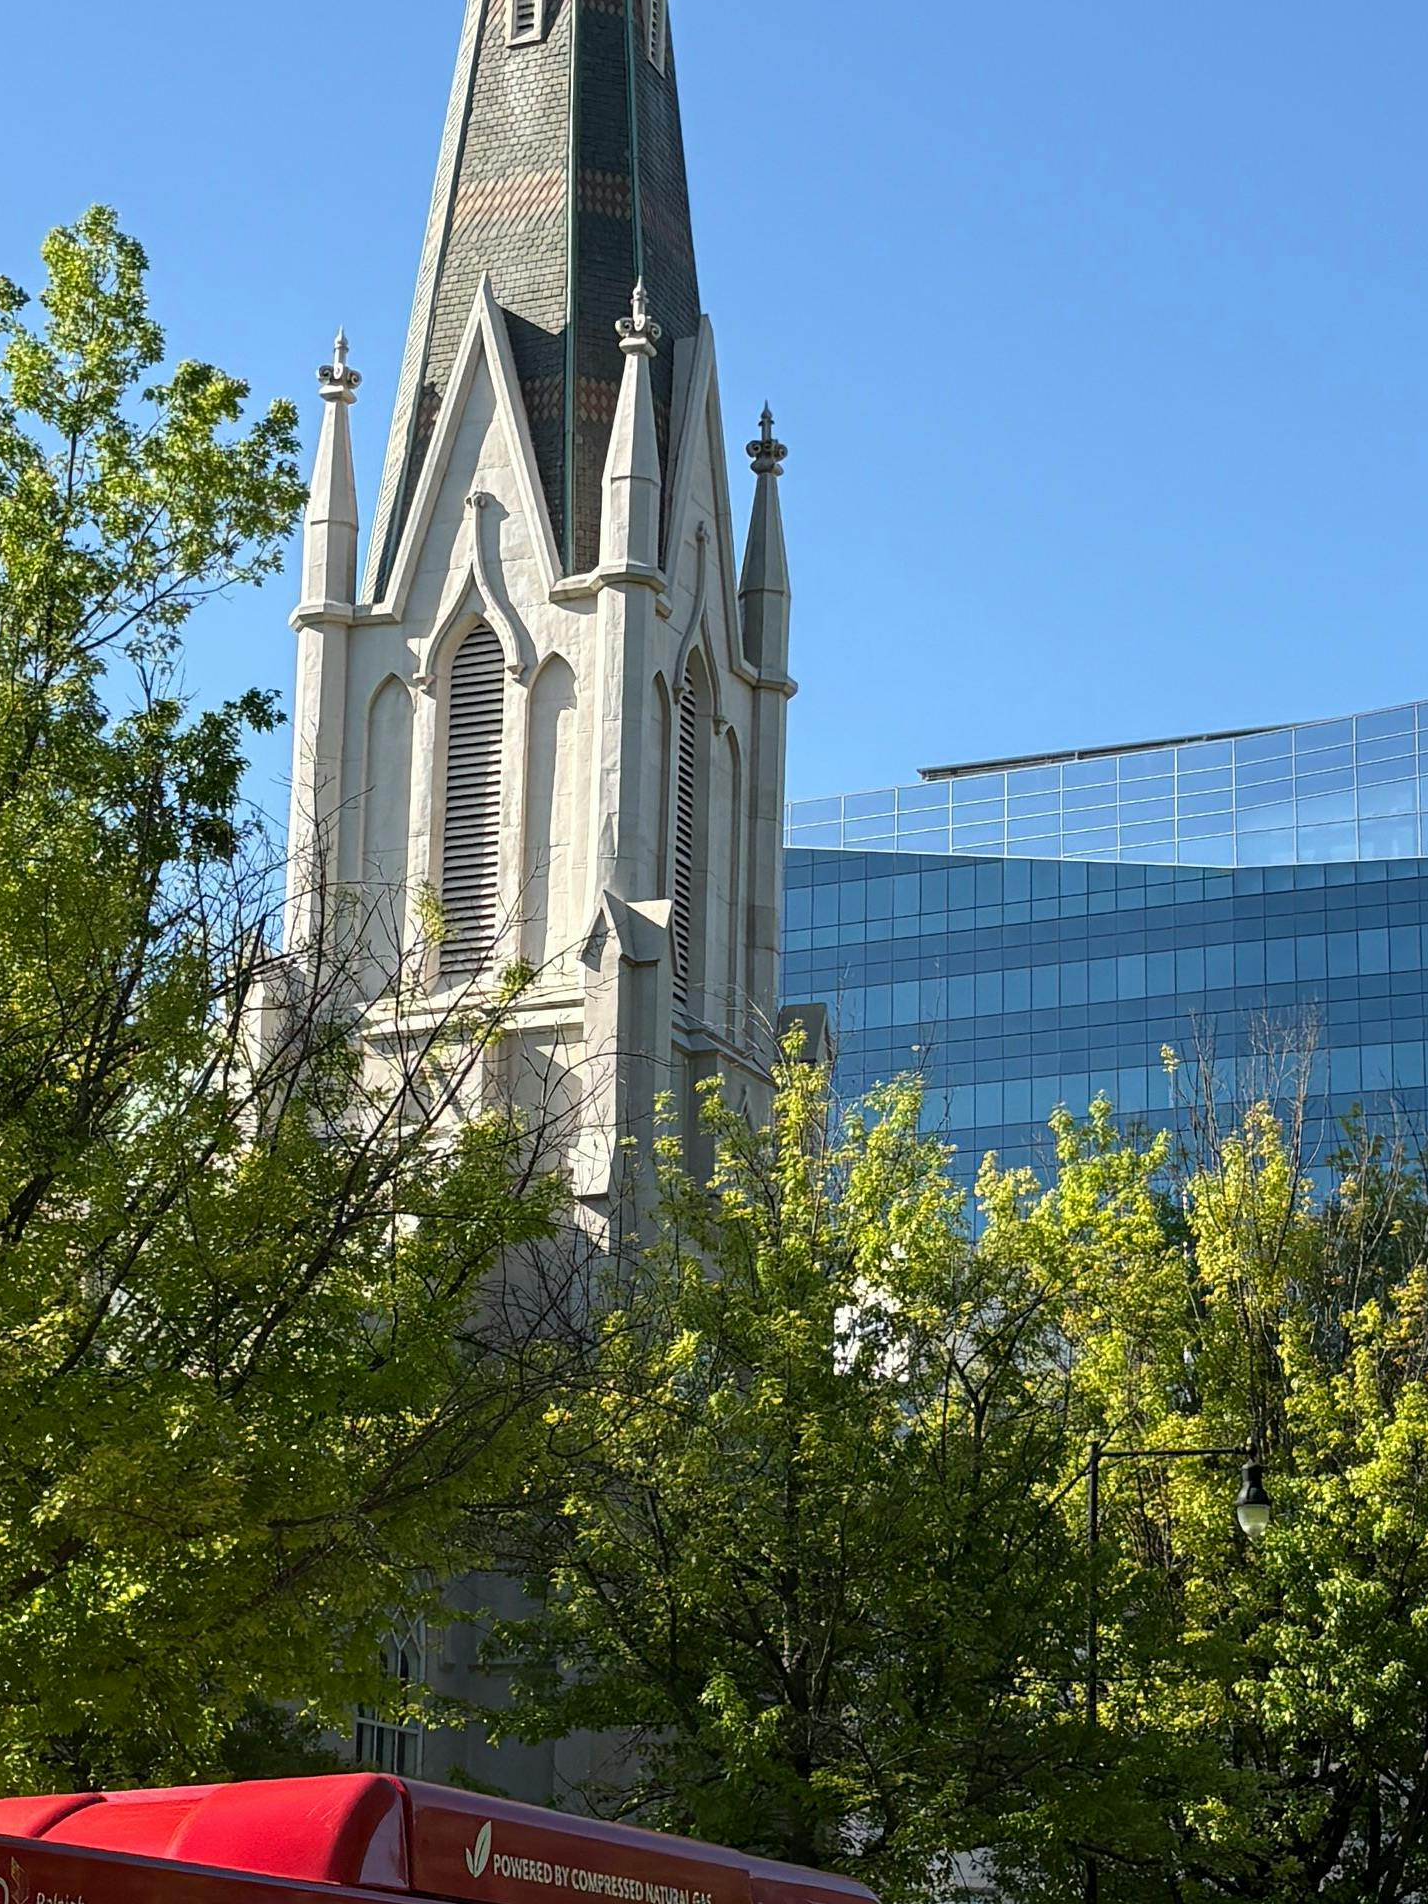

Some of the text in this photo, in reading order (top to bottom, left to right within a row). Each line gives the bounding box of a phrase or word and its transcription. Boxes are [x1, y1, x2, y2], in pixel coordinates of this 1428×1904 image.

[493, 1853, 553, 1886] POWERED
[554, 1867, 570, 1887] BY
[571, 1869, 644, 1902] COMPRESSED
